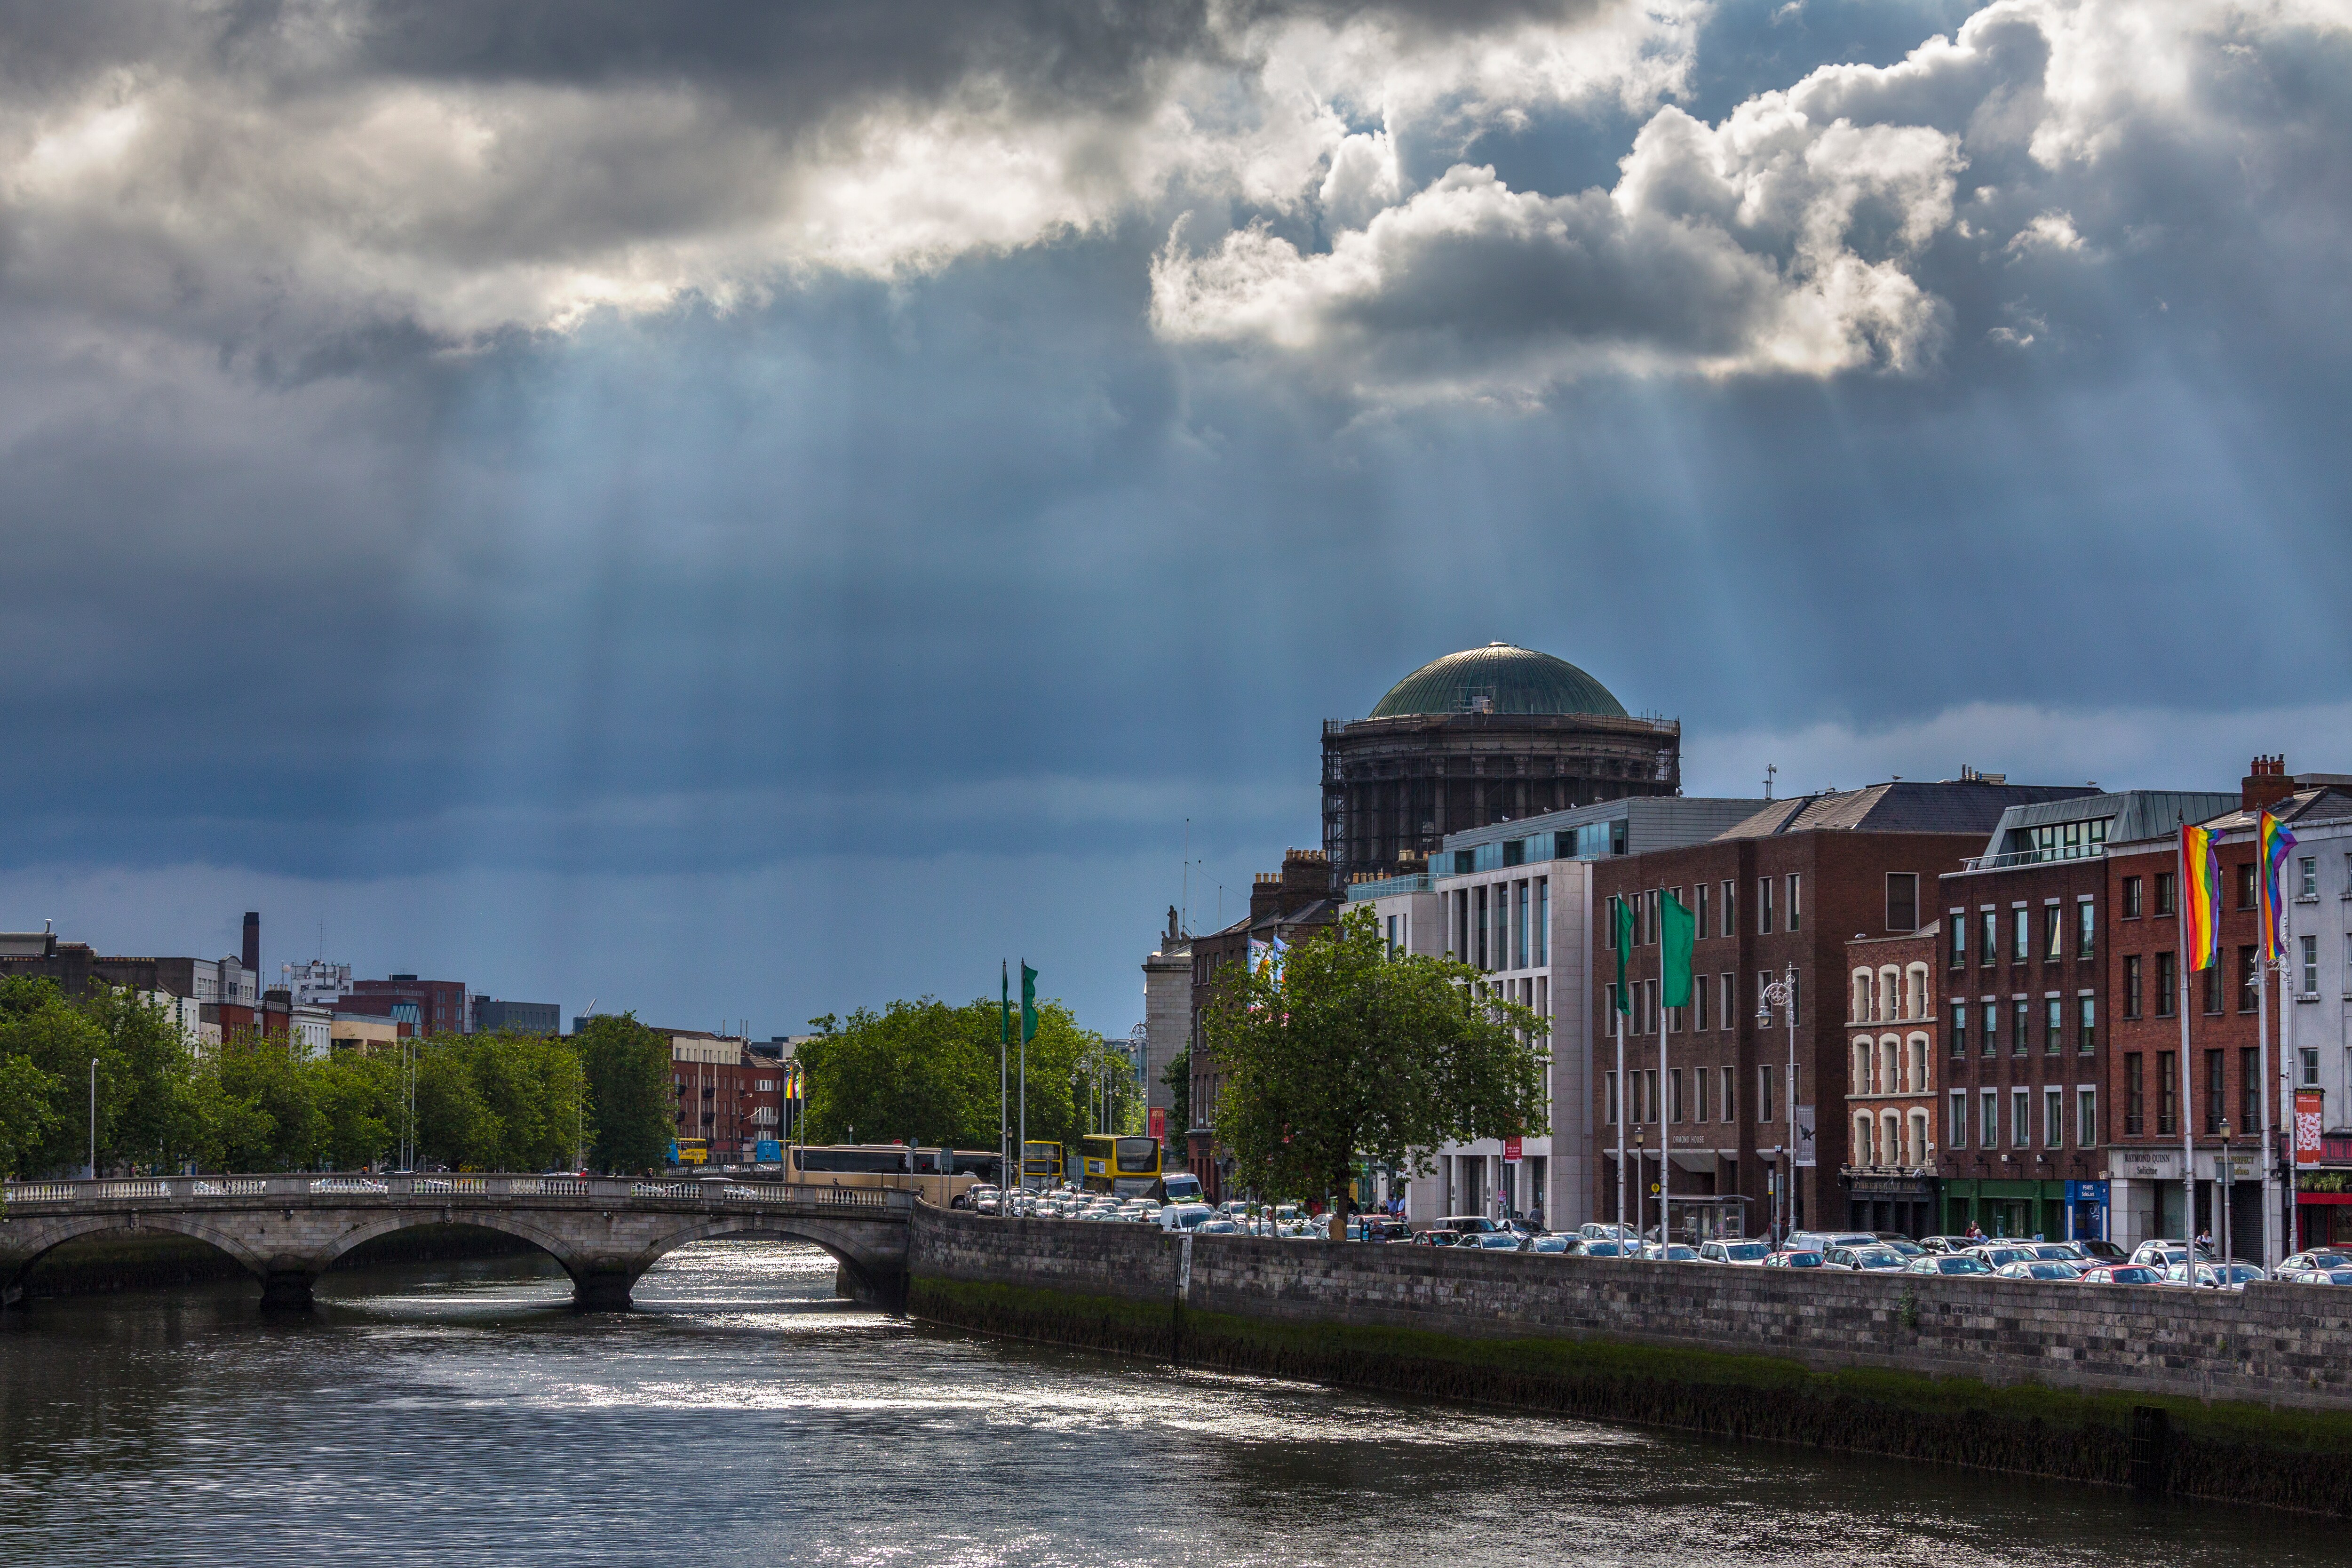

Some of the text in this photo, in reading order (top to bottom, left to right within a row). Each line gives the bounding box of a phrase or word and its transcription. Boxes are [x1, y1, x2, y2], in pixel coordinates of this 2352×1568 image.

[1248, 945, 1272, 957] FESTIVL
[2330, 1142, 2343, 1157] THE
[2152, 1154, 2169, 1164] QUINN
[2137, 1166, 2158, 1175] Solicitor
